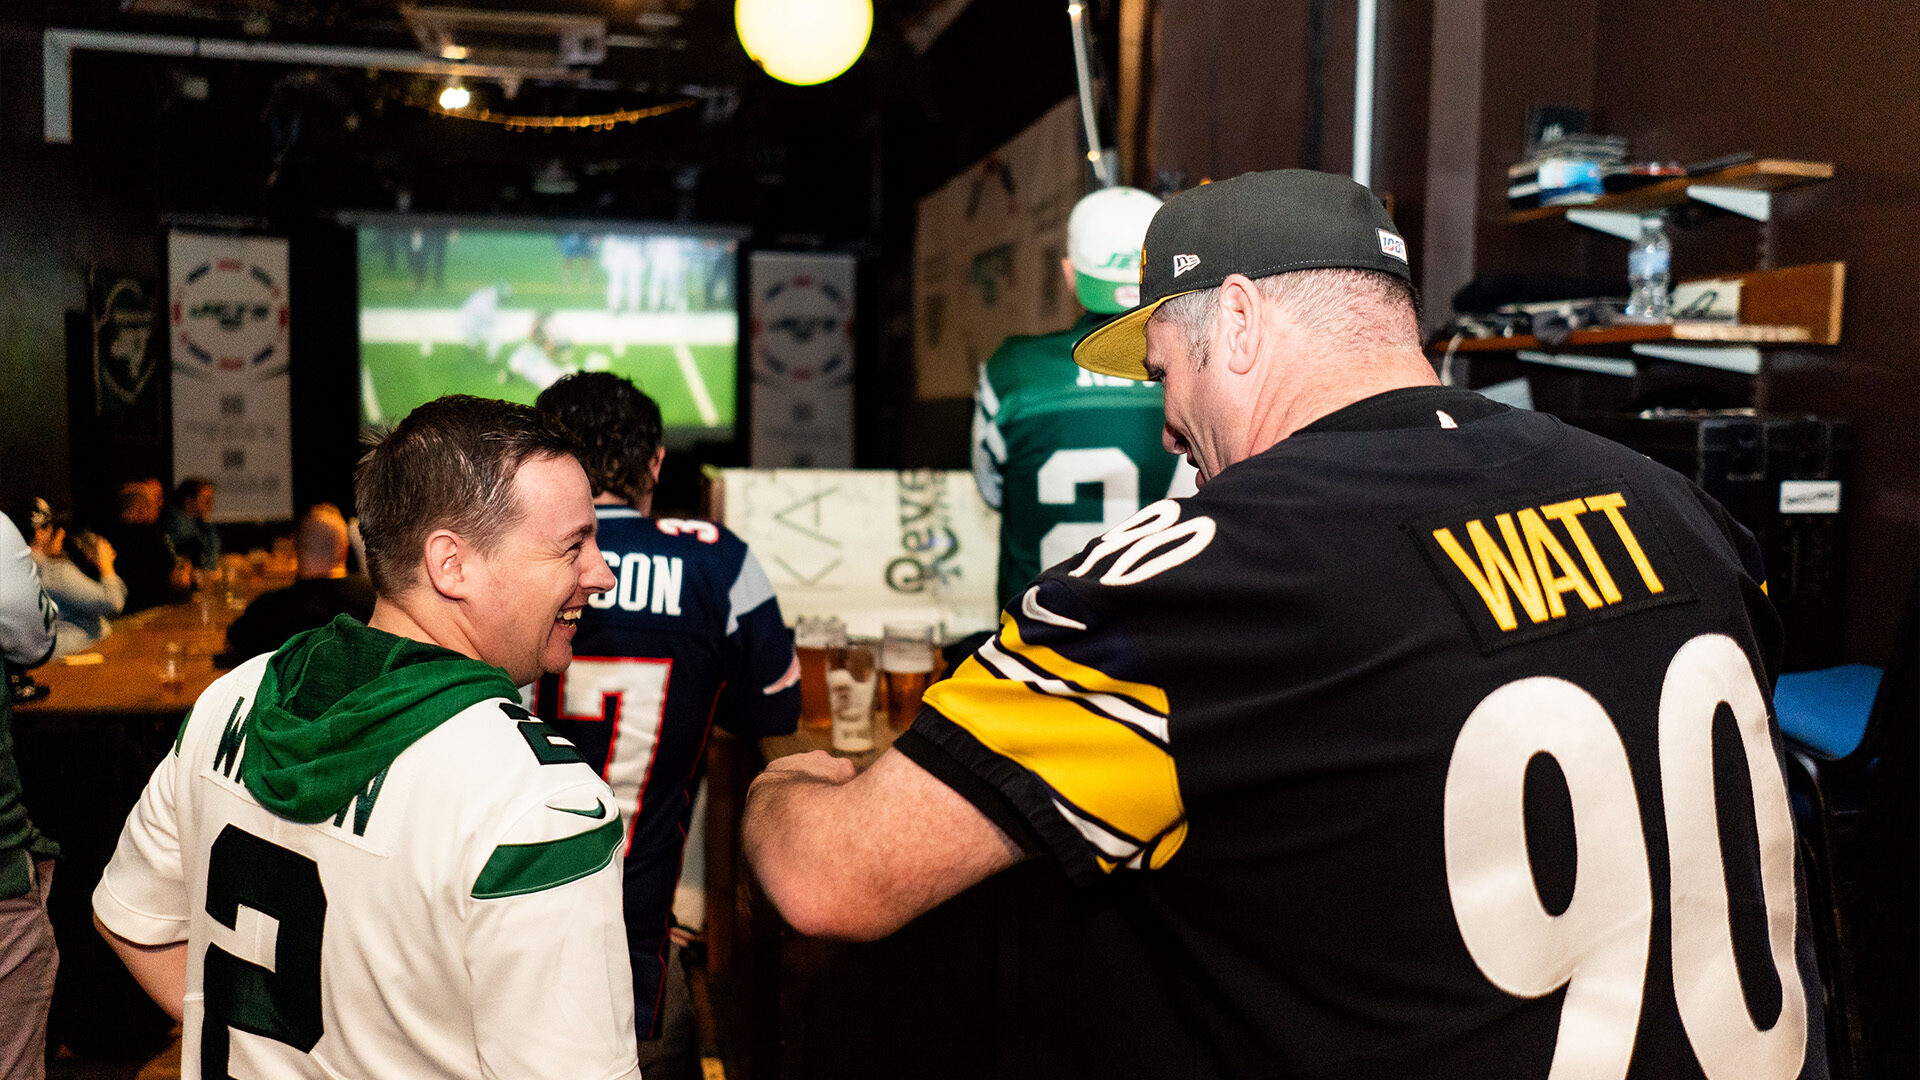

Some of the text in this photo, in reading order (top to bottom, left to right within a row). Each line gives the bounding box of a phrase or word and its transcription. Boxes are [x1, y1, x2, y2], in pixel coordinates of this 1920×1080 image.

[1066, 499, 1217, 586] 90
[1432, 492, 1663, 633] WATT
[201, 823, 328, 1080] 2
[1443, 634, 1807, 1080] 90
